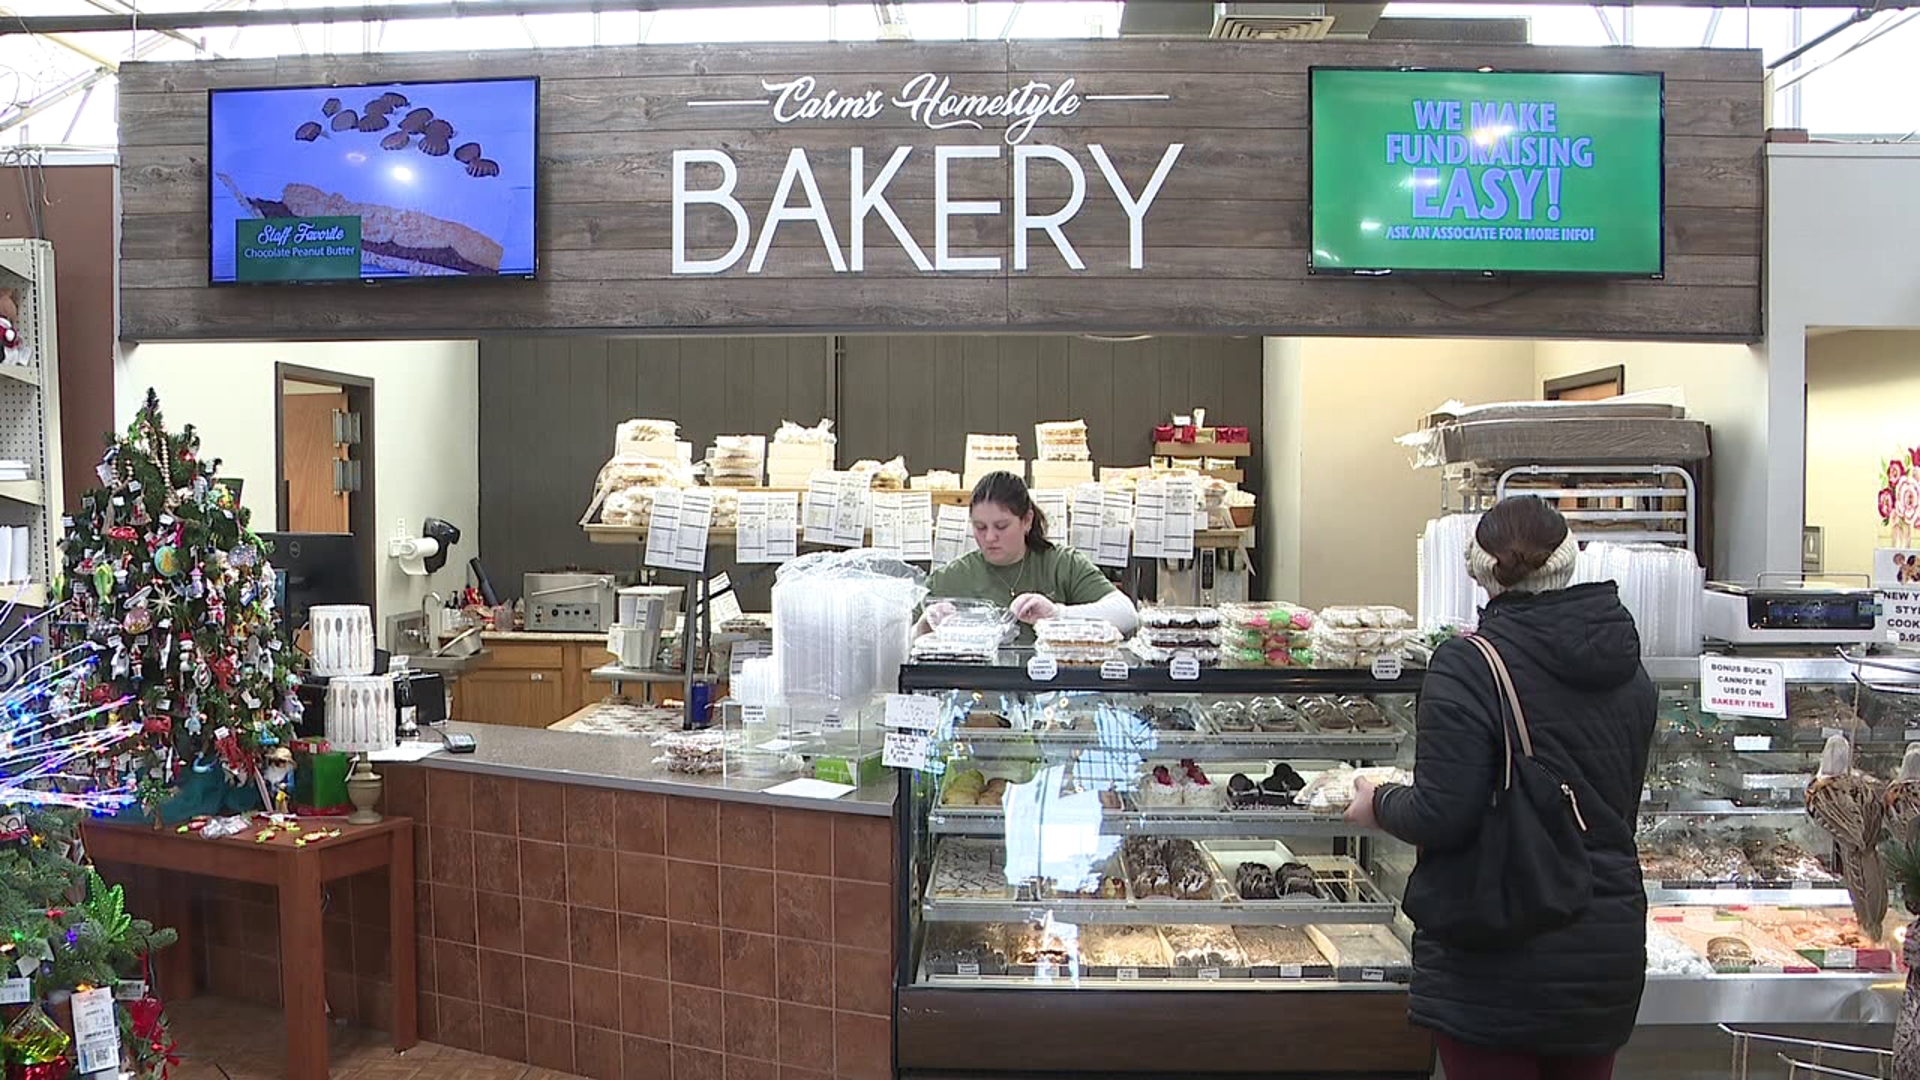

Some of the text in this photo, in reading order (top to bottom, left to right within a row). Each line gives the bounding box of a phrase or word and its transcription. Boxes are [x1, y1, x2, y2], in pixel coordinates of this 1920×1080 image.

[761, 72, 1081, 146] Carm's Homestyle
[1412, 99, 1557, 133] WE MAKE
[1386, 133, 1594, 168] FUNDRAISING
[1412, 166, 1561, 222] EASY!
[671, 143, 1185, 274] BAKERY
[257, 222, 345, 246] Staff Favorite
[1385, 226, 1595, 242] ASK AN ASSOCIATE FOR MORE INFO!
[244, 245, 355, 258] Chocolate Peanut Butter
[1883, 591, 1909, 600] NEW
[1711, 663, 1773, 675] BONUS BUCKS
[1717, 675, 1753, 685] CANNOT
[1723, 687, 1747, 695] USED
[1711, 697, 1775, 709] BAKERY ITEMS
